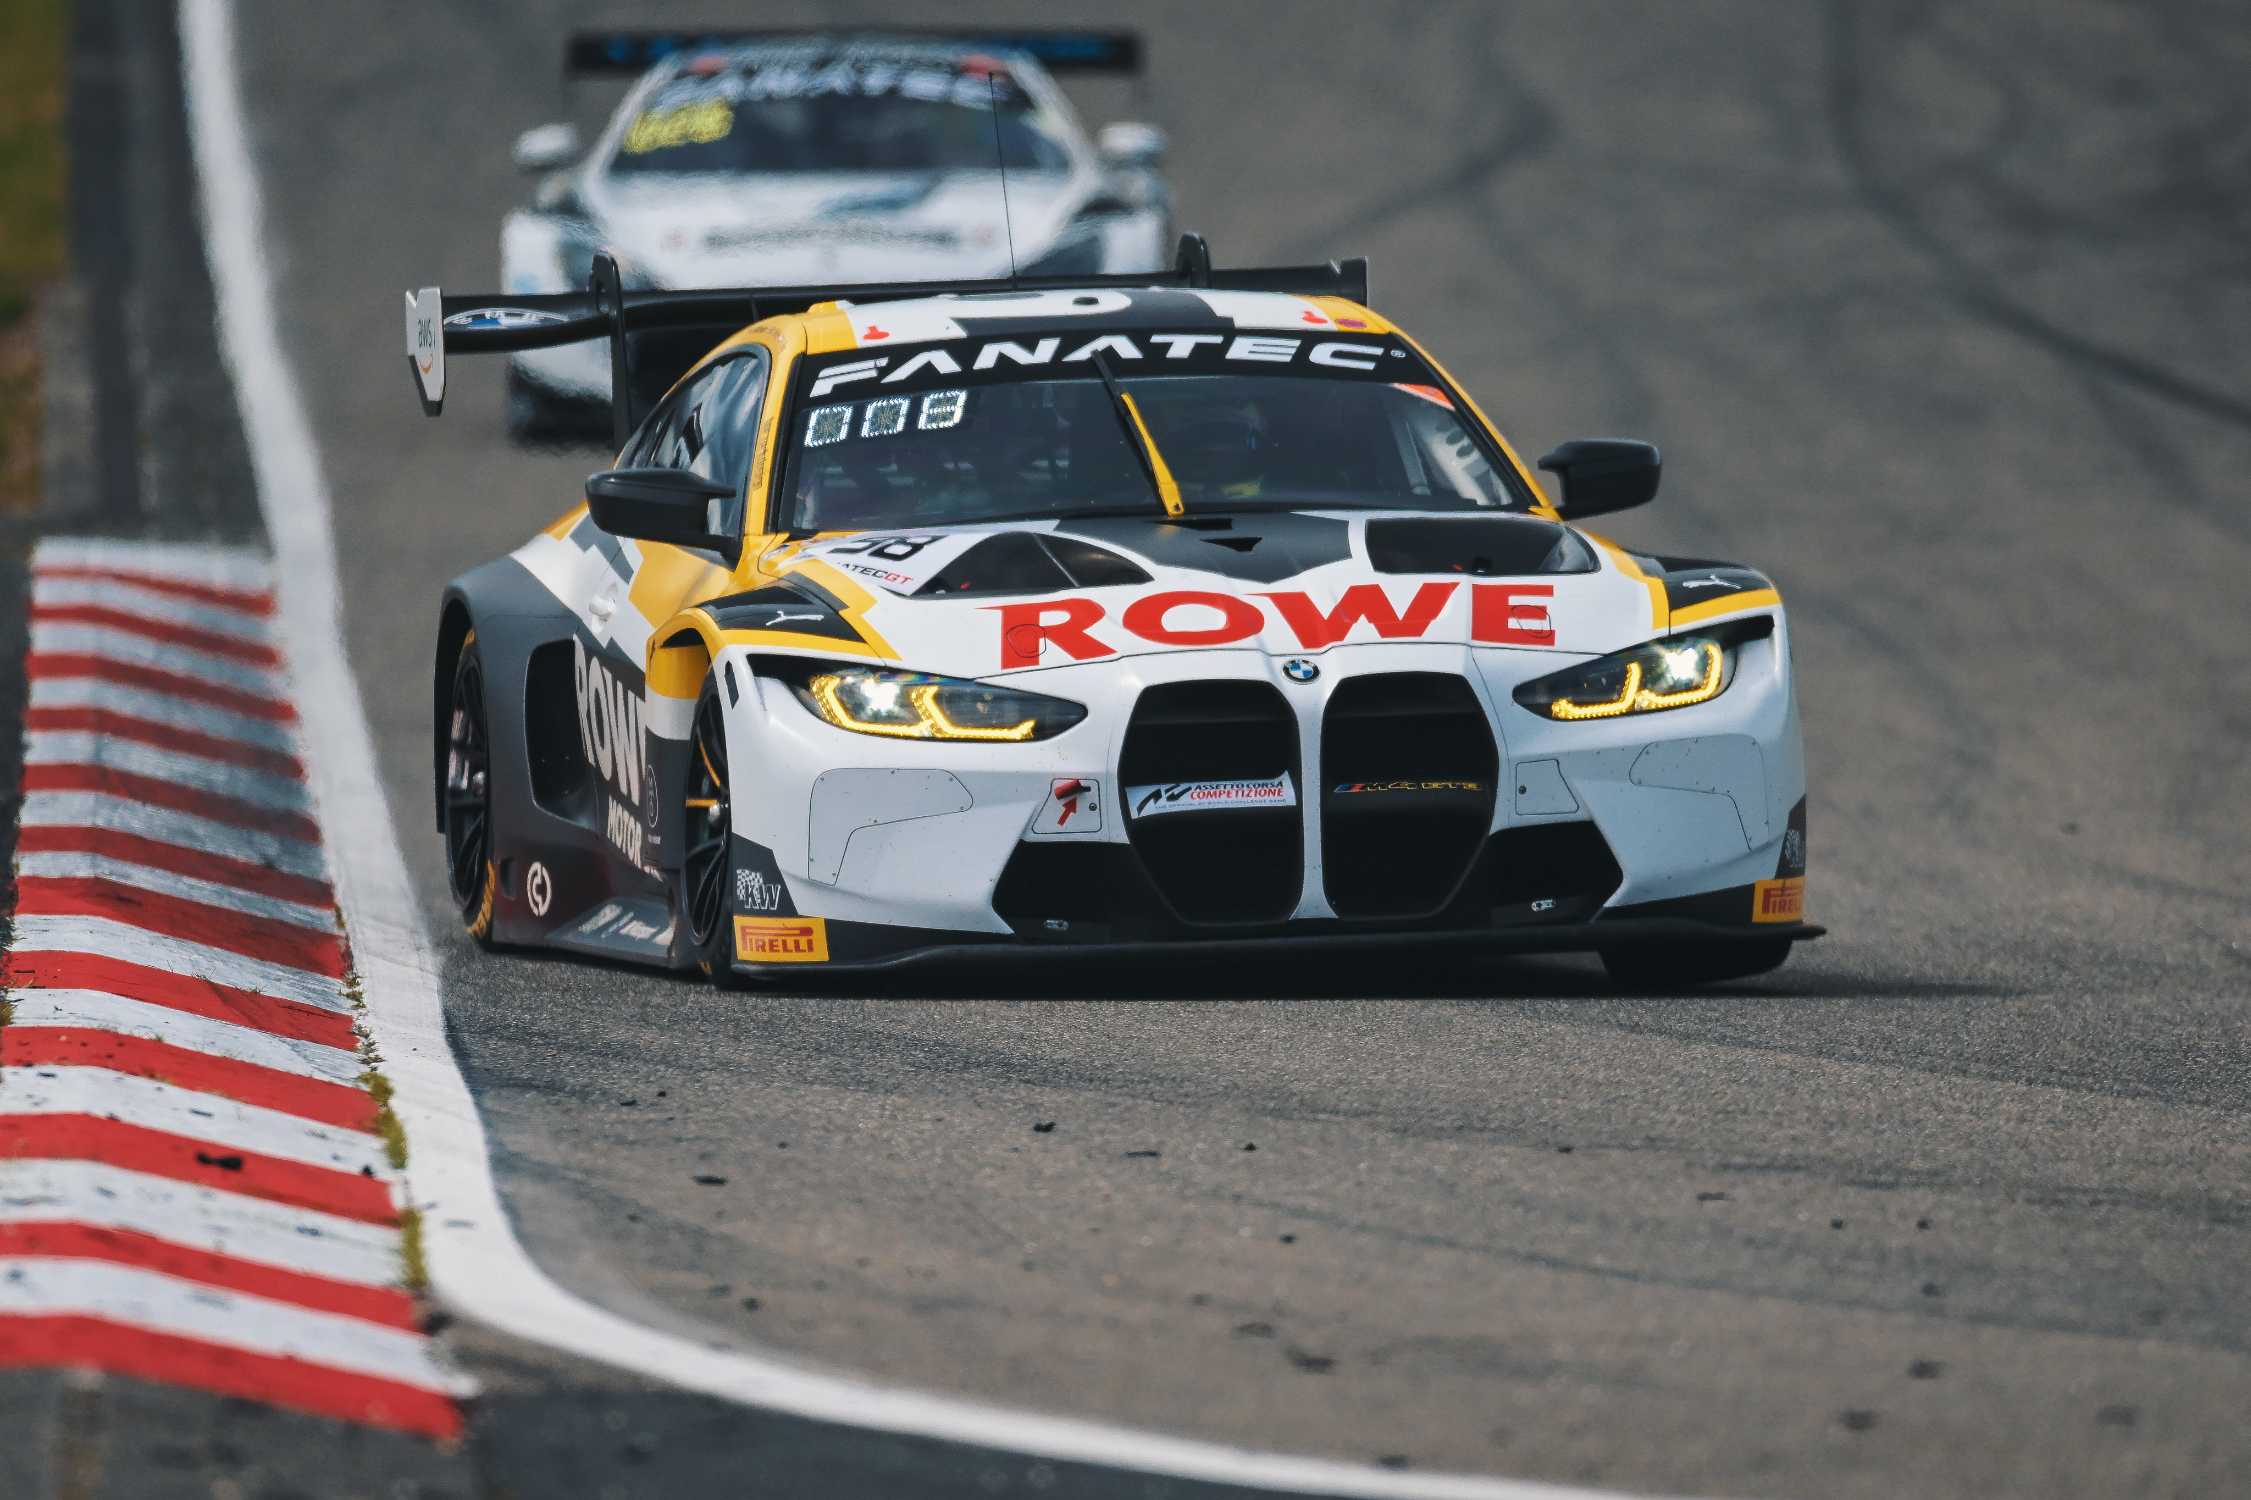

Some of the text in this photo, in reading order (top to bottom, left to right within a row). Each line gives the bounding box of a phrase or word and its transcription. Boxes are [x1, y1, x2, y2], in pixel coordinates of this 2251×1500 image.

[809, 334, 1384, 398] FANATEC
[804, 390, 967, 447] 008
[976, 581, 1556, 670] ROWE
[1190, 788, 1284, 801] COMPETIZIONE
[1194, 781, 1284, 791] ASSETTO CORSA
[607, 794, 642, 869] MOTOR
[743, 883, 782, 911] KW
[741, 926, 815, 953] PIRELLI
